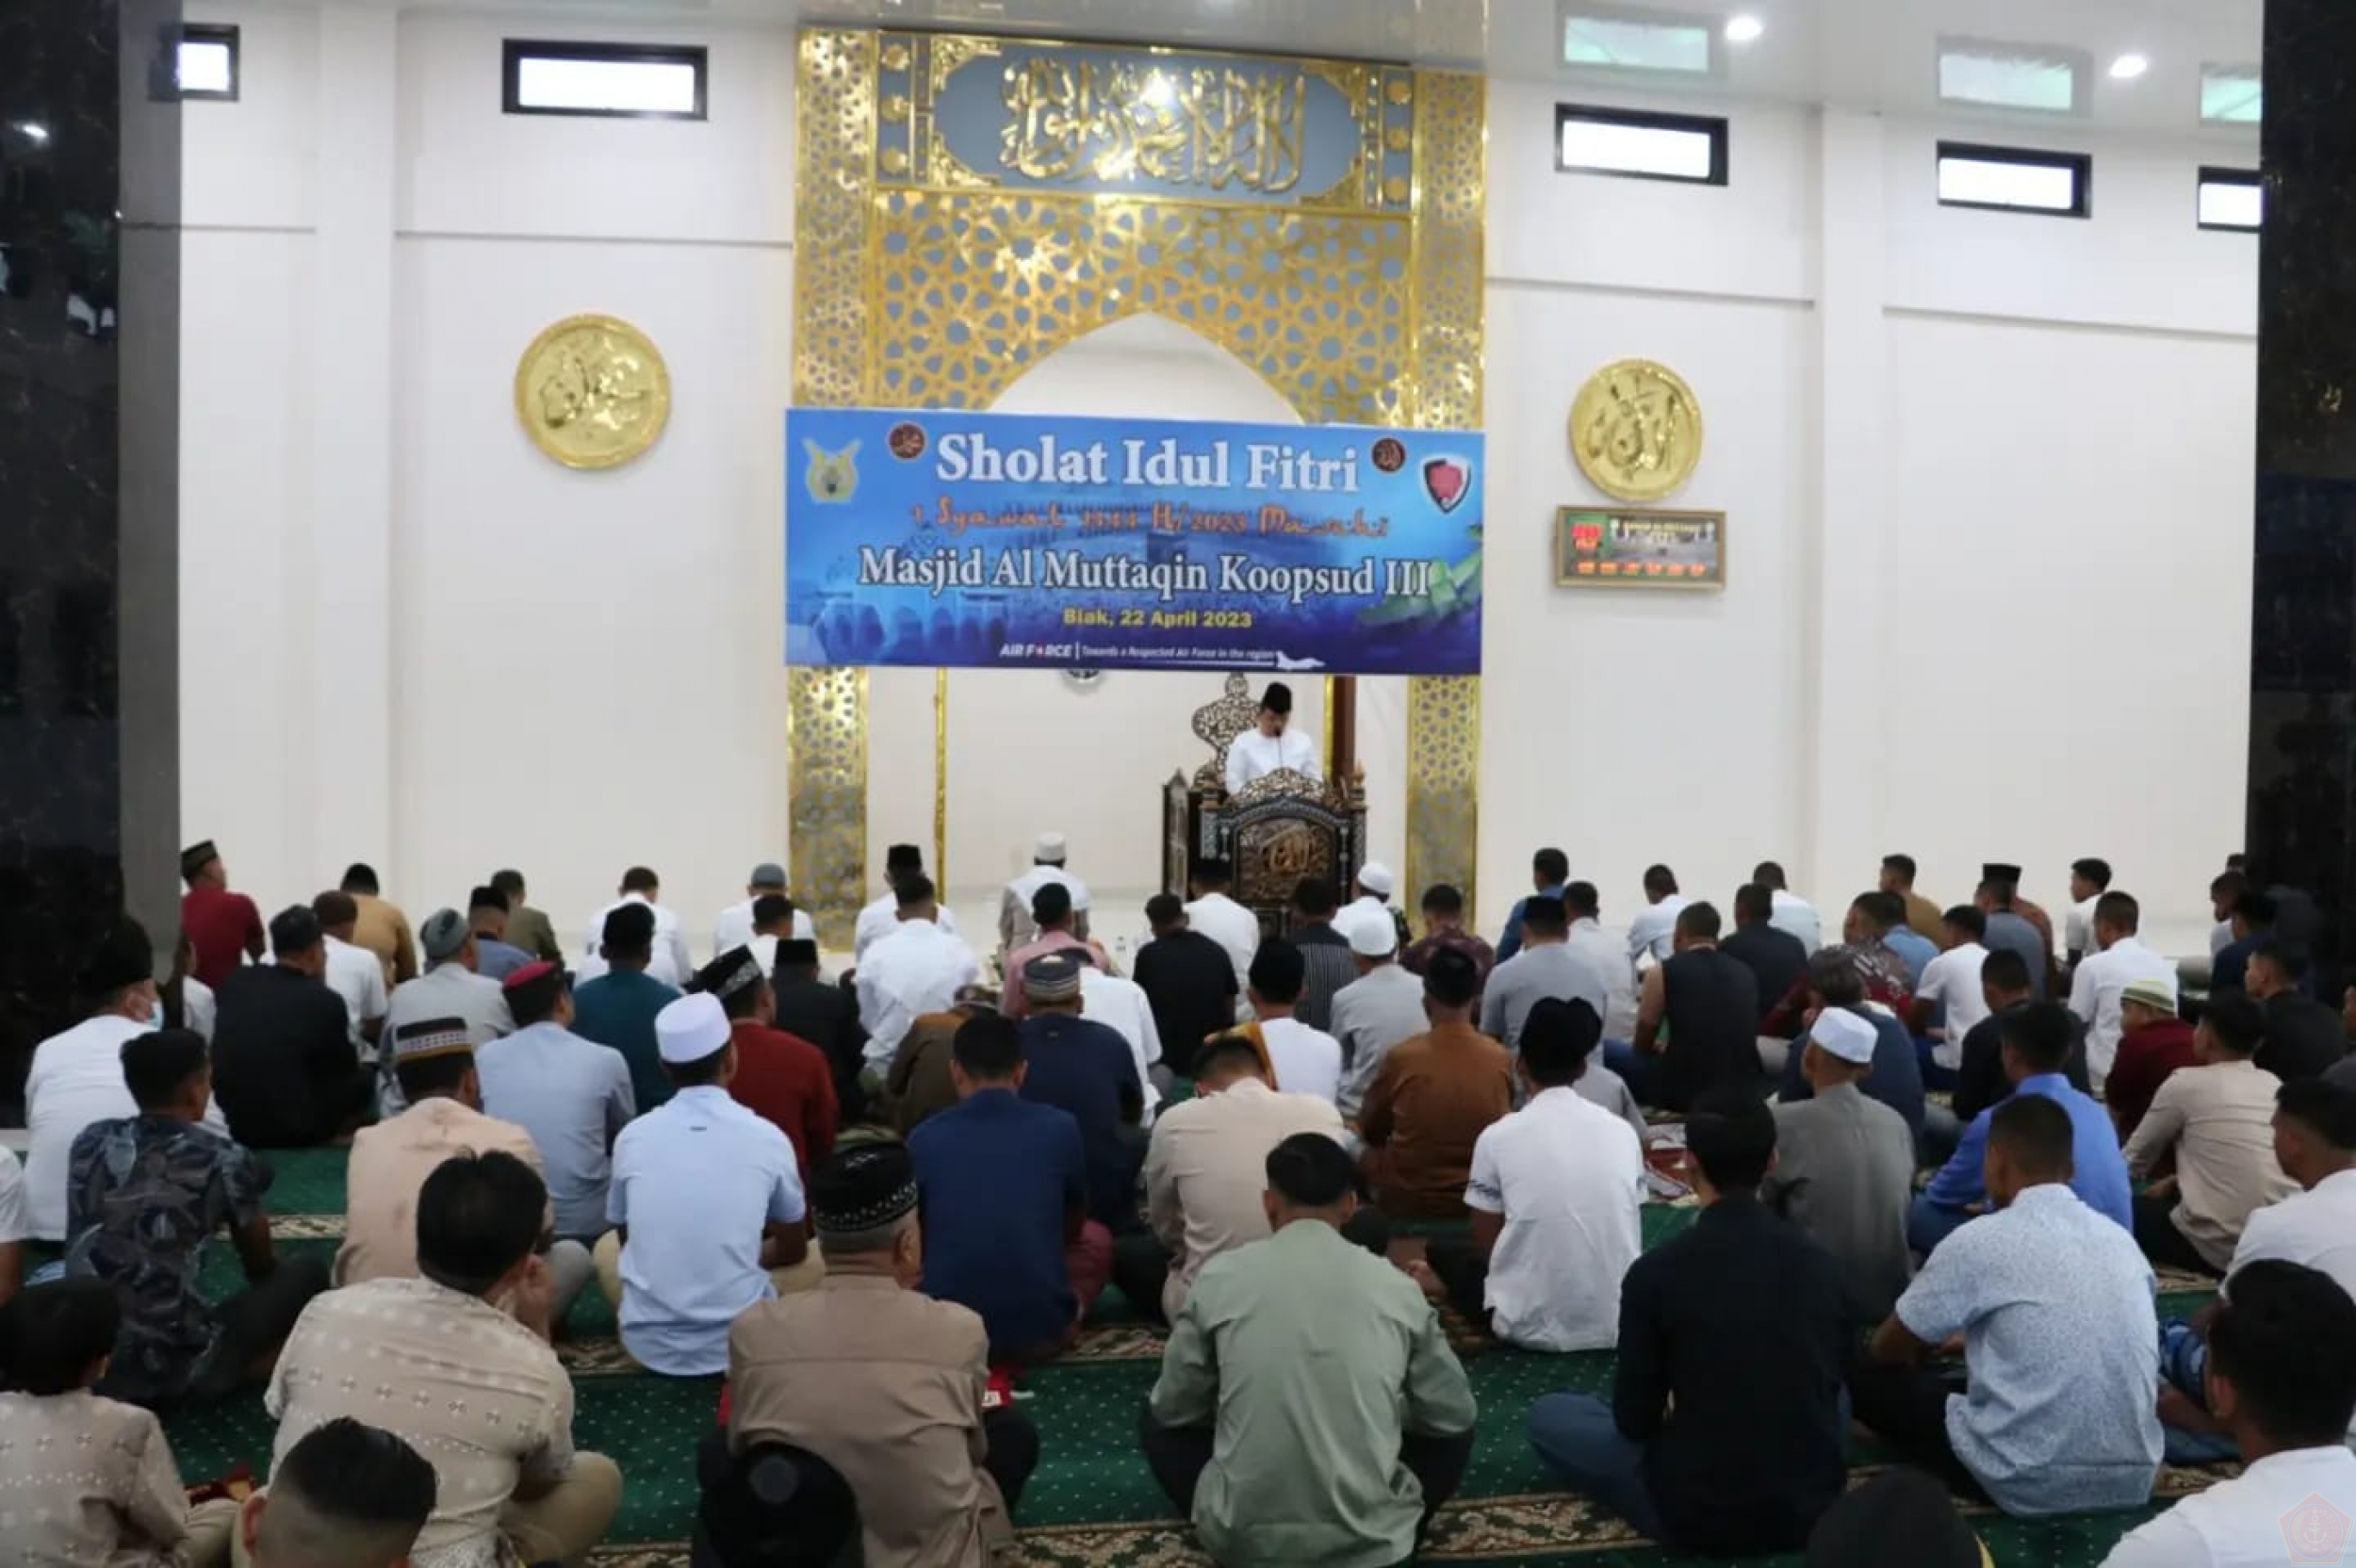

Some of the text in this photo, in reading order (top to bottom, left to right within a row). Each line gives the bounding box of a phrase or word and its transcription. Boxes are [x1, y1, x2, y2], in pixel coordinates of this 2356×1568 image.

[936, 433, 1108, 483] Sholat
[1122, 438, 1231, 488] Idul
[1245, 444, 1359, 492] Fitri
[859, 547, 1430, 604] Masjid Al Muttaqin Koopsud III
[1119, 611, 1144, 627] 22
[1151, 611, 1197, 629] April
[1203, 612, 1252, 629] 2023
[1000, 644, 1023, 658] AIR
